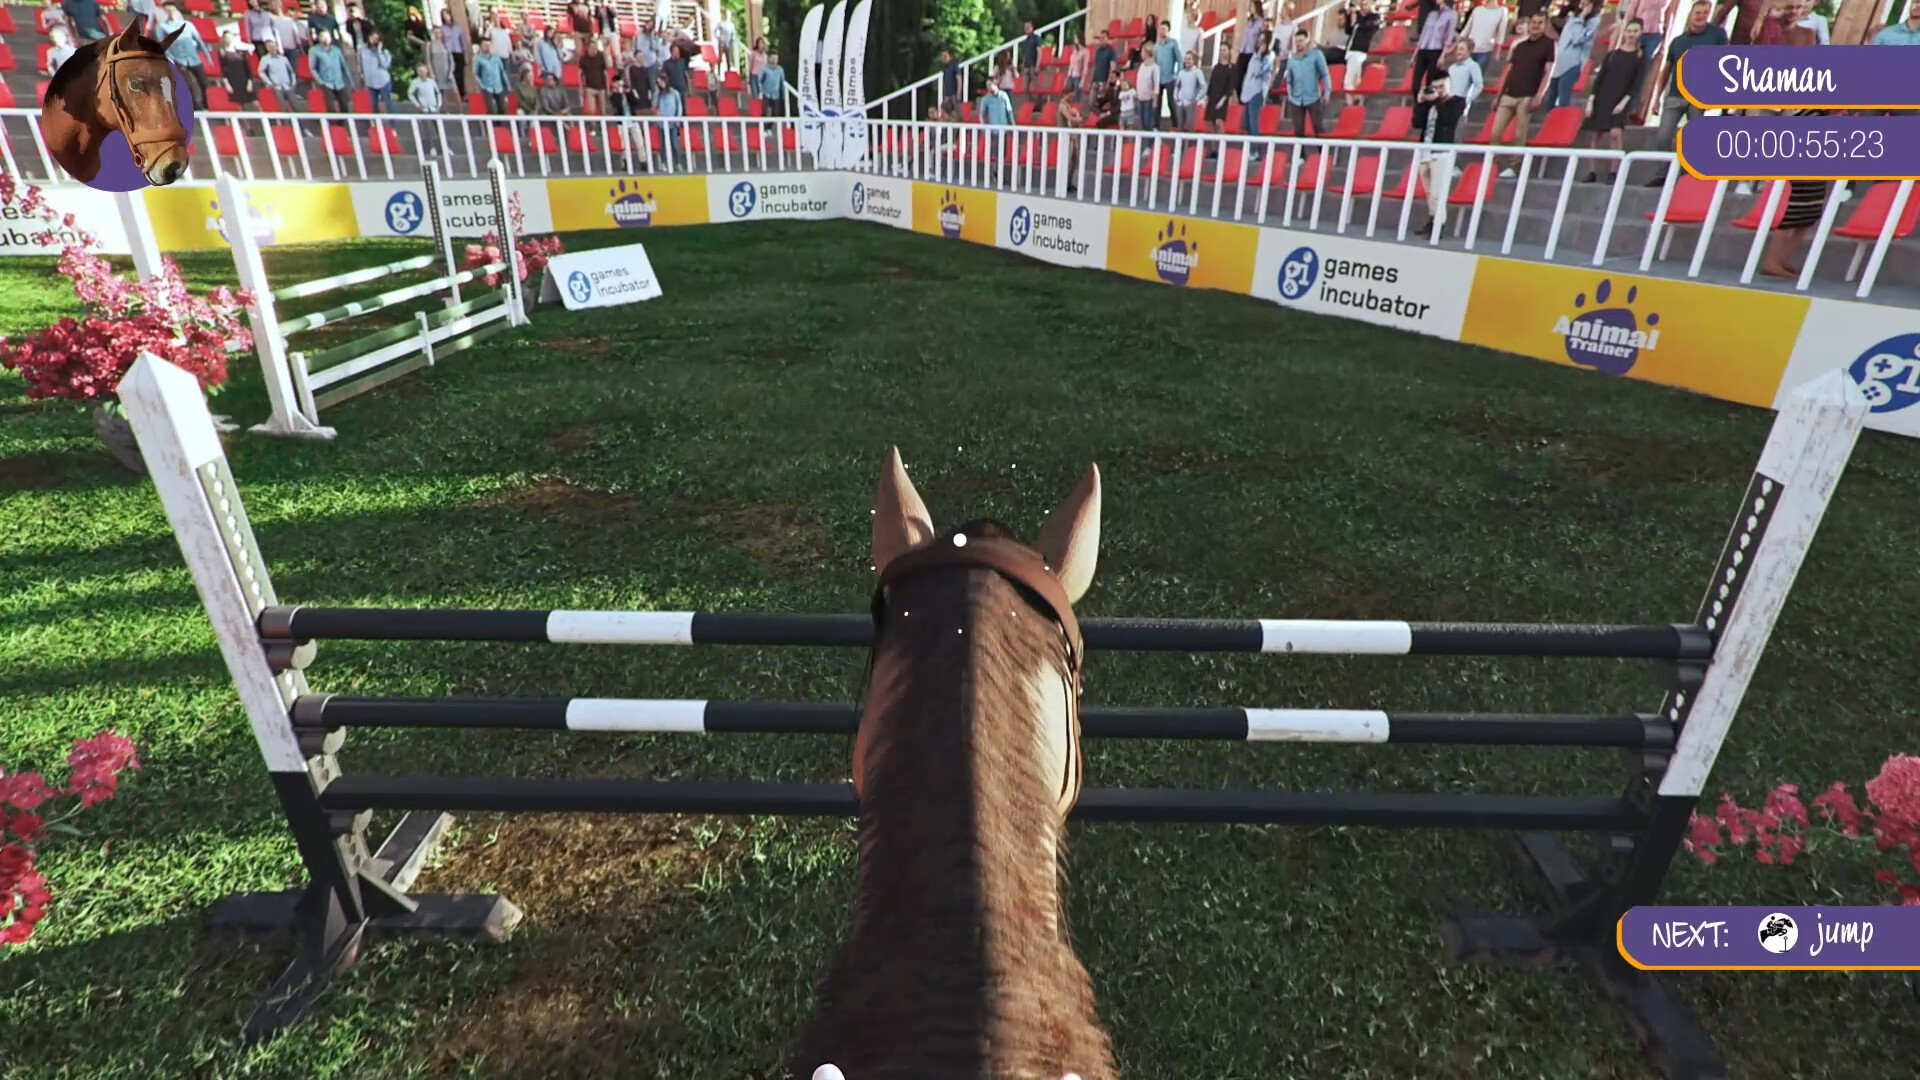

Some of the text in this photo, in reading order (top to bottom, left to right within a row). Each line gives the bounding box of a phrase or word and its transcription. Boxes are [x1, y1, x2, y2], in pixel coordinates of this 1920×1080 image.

[824, 59, 834, 107] games
[847, 58, 856, 107] games
[442, 193, 494, 208] ames
[760, 184, 807, 199] games
[761, 199, 828, 213] incubator
[1033, 213, 1072, 230] games
[1032, 230, 1090, 255] incubator
[1151, 247, 1198, 267] Animal
[590, 267, 629, 284] games
[1323, 257, 1399, 282] games
[597, 279, 650, 297] incubator
[1319, 281, 1430, 320] incubator
[1552, 314, 1660, 350] Animal
[1569, 337, 1634, 359] Trainer
